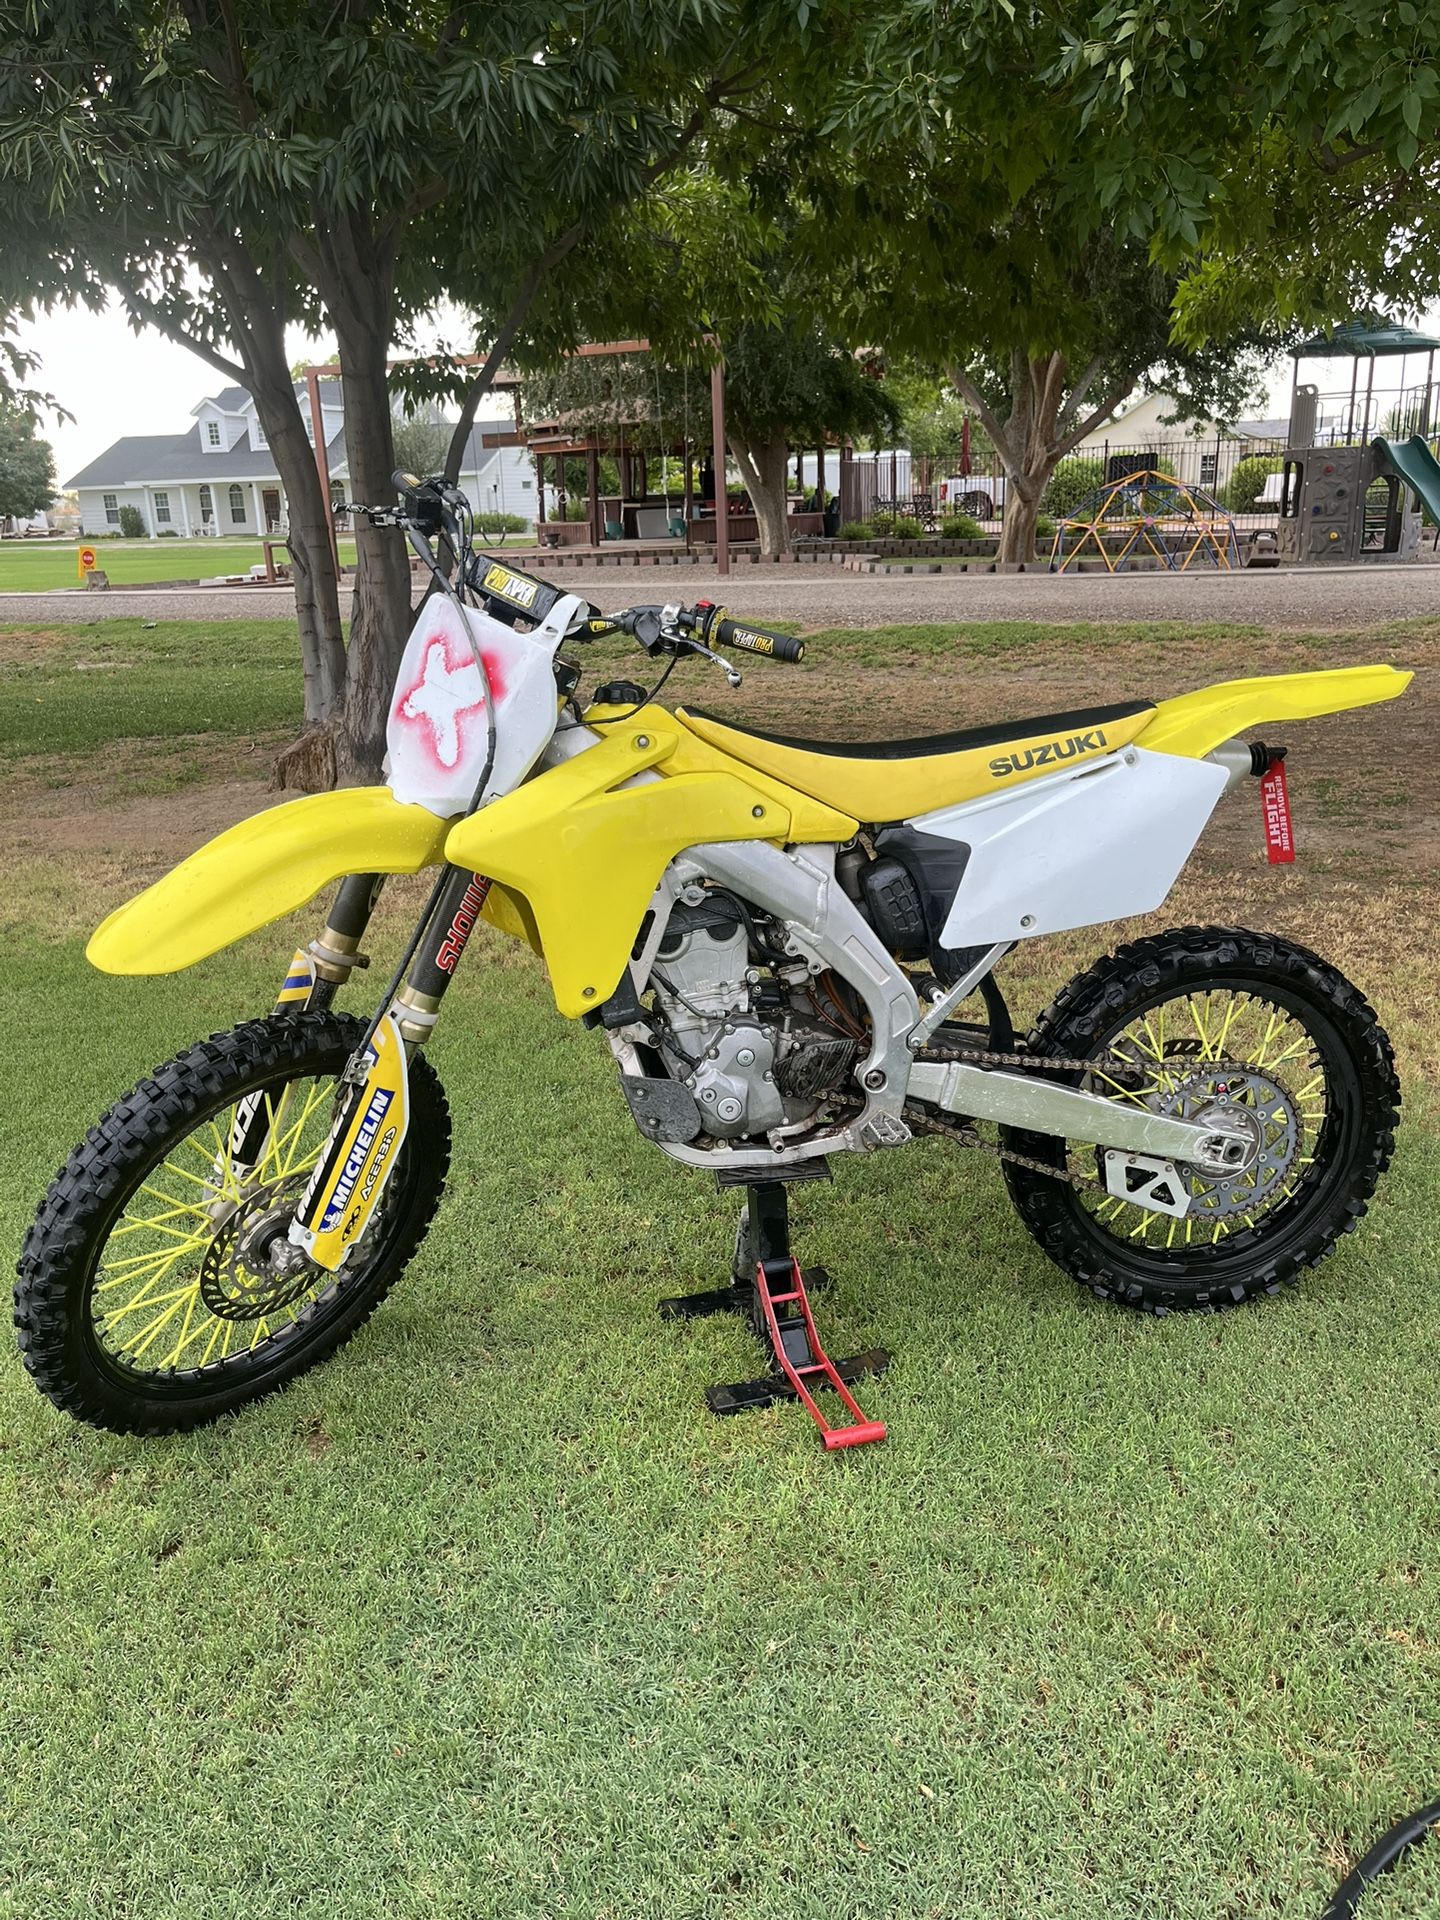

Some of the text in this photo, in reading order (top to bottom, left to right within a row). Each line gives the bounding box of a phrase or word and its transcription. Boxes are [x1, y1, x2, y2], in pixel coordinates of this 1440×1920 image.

[988, 729, 1108, 777] SUZUKI
[1264, 781, 1282, 847] FLIGHT
[1274, 775, 1290, 851] REMOVE BEFORE
[331, 1091, 389, 1210] MICHELIN
